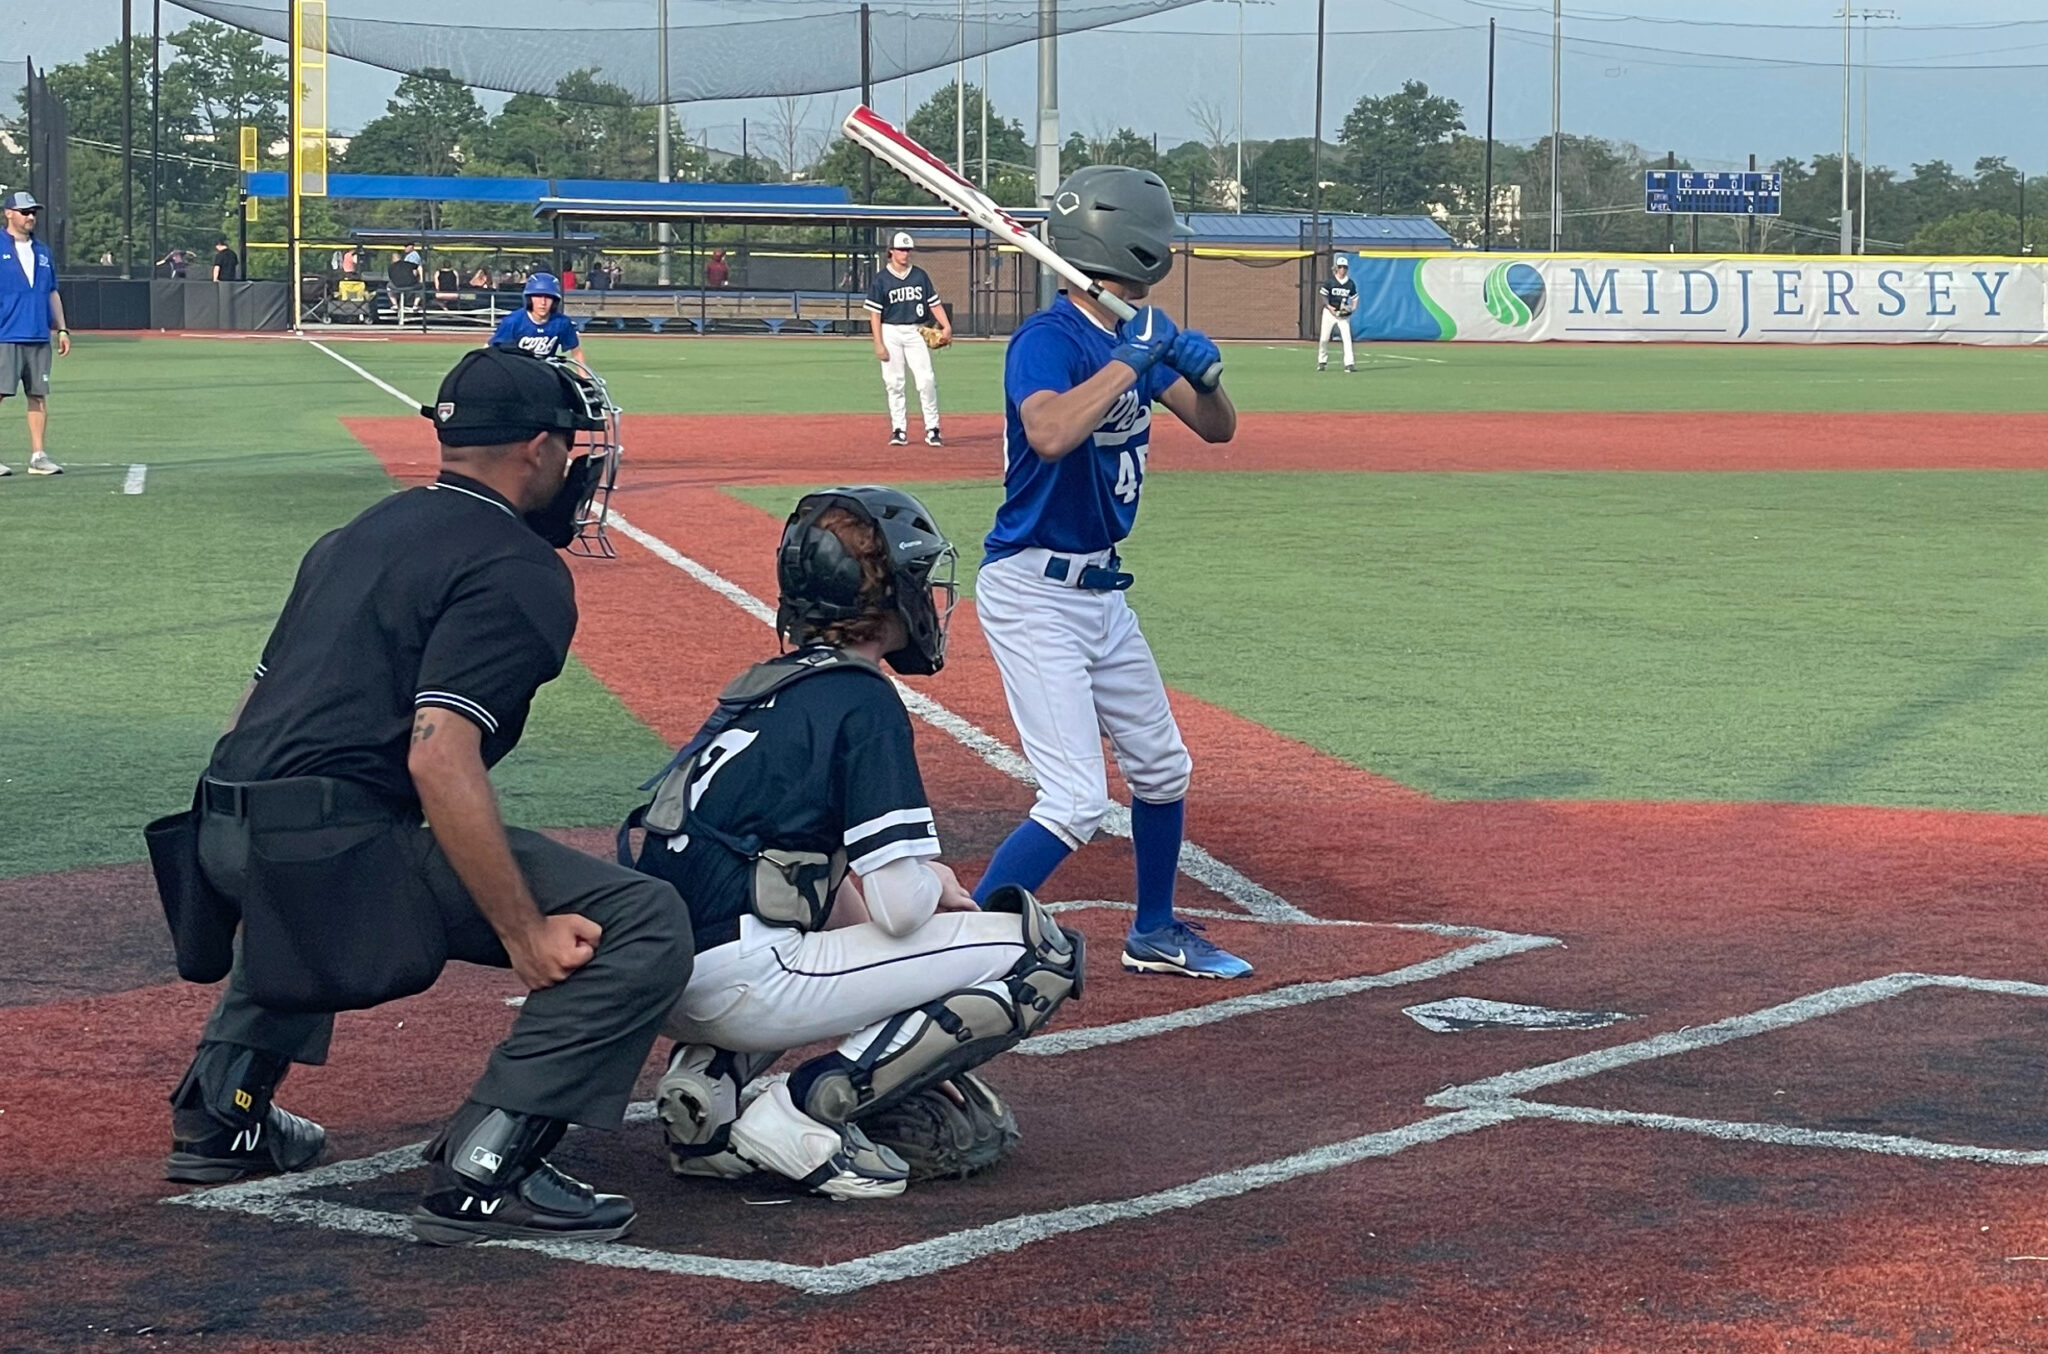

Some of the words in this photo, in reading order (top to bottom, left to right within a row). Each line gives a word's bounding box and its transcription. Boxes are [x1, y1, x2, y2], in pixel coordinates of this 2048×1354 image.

[888, 286, 923, 304] CUBS
[1568, 268, 2010, 337] MIDJERSEY
[916, 303, 924, 317] 6
